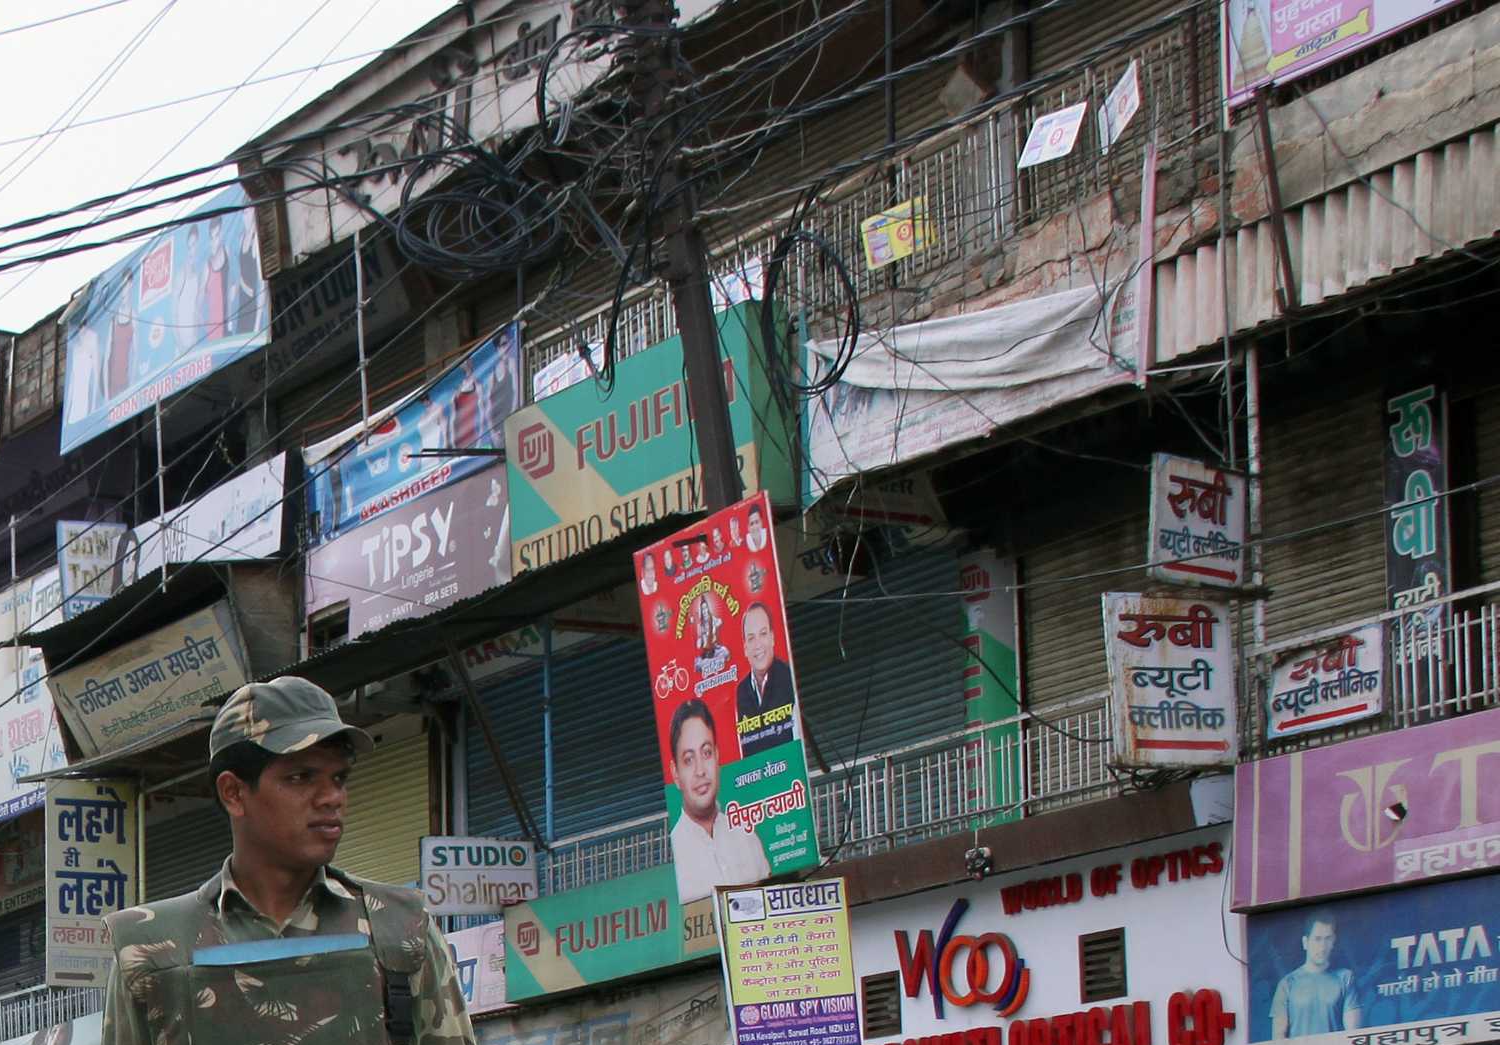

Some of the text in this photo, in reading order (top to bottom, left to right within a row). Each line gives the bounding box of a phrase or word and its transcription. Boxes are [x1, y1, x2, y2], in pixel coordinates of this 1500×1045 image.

[1130, 658, 1212, 696] ब्यूटी
[1129, 700, 1225, 730] क्लीनिक
[726, 779, 806, 834] विपुल त्यागी
[62, 847, 80, 867] ही
[431, 845, 527, 868] STUDIO
[427, 873, 533, 907] Shalimar
[1001, 842, 1224, 915] WORLD OF OPTICS
[767, 882, 841, 912] सावधान
[555, 899, 667, 956] FUJIFILM
[683, 912, 717, 942] SHA
[1391, 925, 1491, 970] TATA
[1422, 971, 1440, 993] हो
[1444, 968, 1462, 989] तो
[761, 996, 855, 1020] GLOBAL SPY VISION
